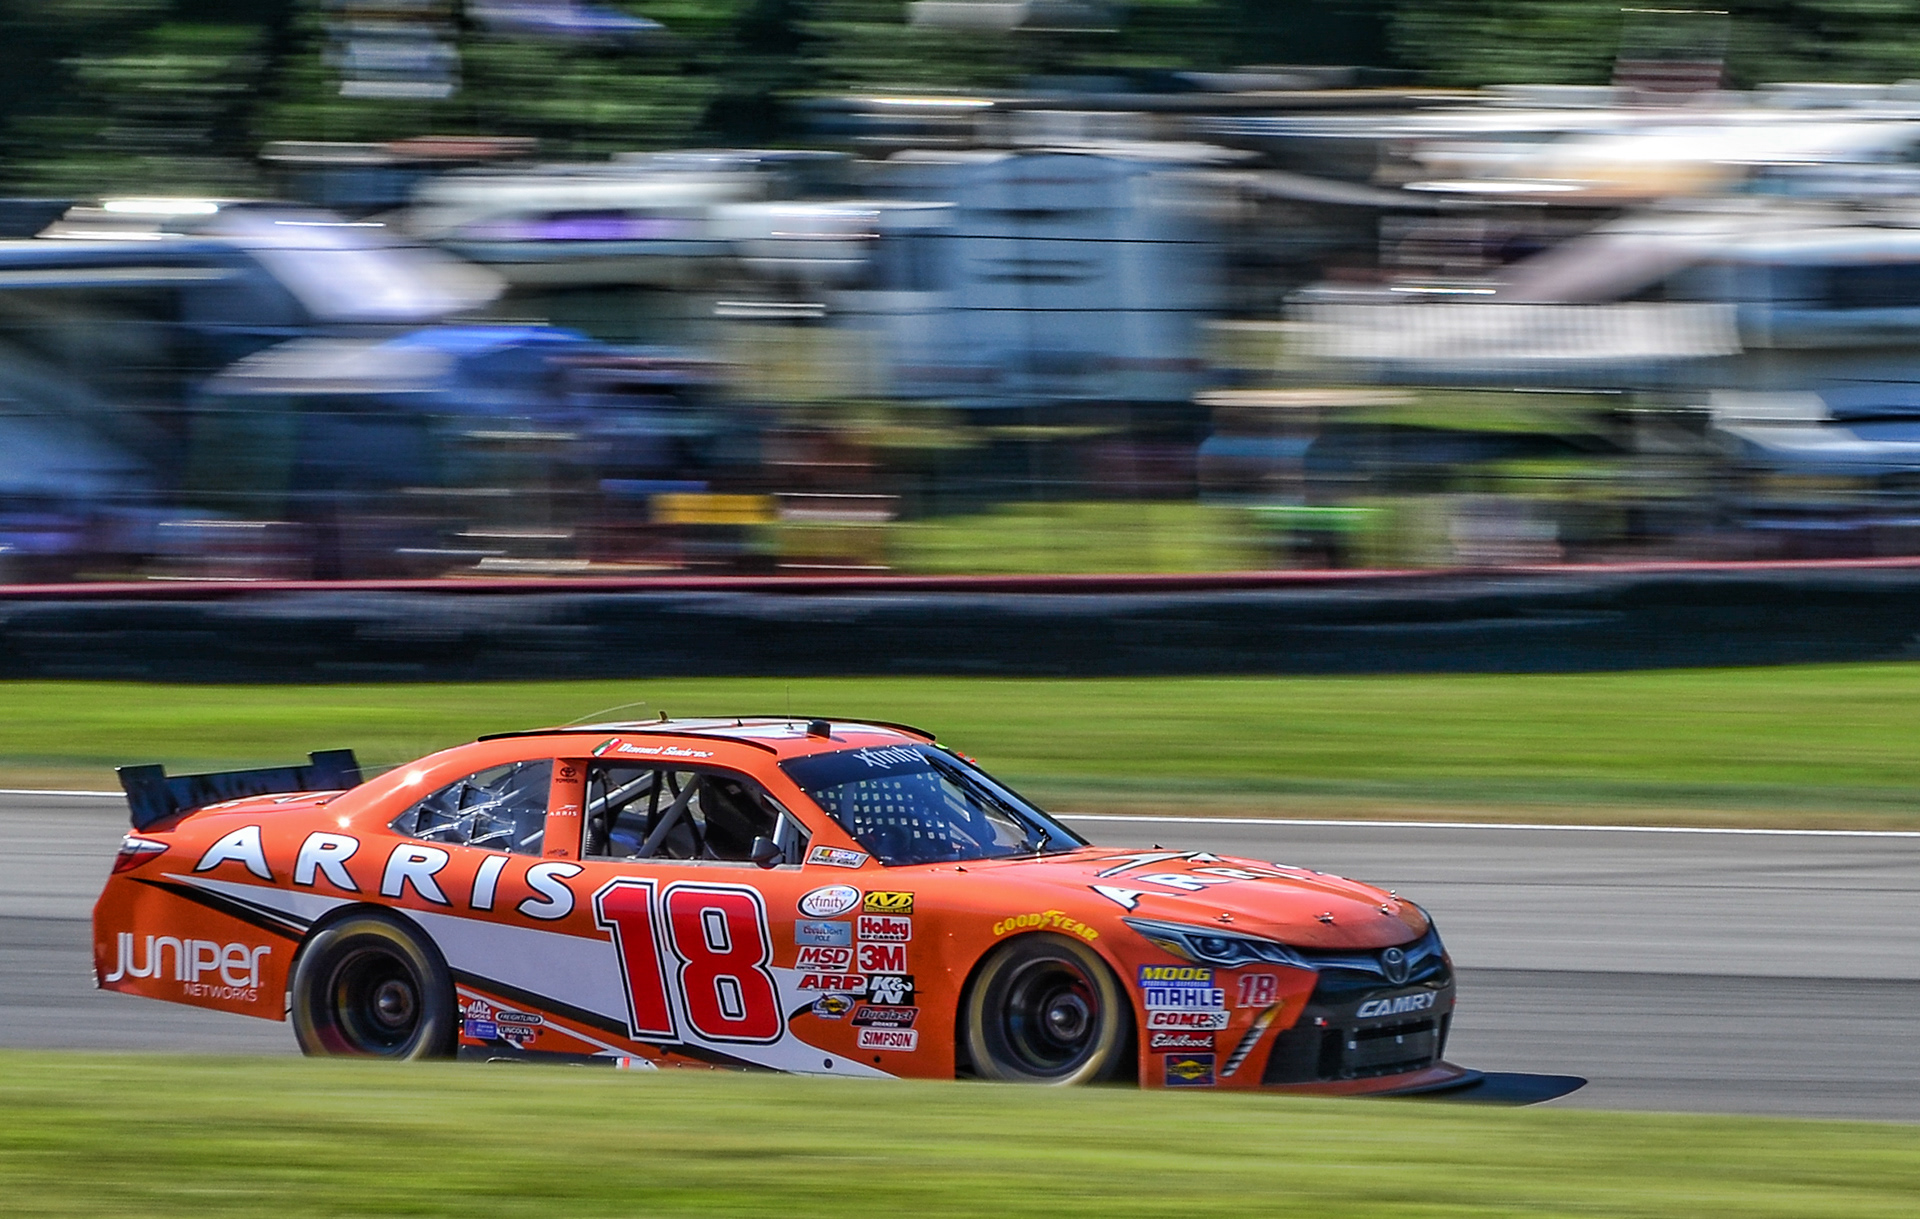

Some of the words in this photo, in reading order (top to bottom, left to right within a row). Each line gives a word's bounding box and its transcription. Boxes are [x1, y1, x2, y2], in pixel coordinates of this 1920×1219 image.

[853, 746, 930, 769] xfinity
[194, 824, 584, 920] ARRIS
[807, 895, 847, 909] xfinity
[861, 917, 908, 940] Holley
[993, 909, 1099, 941] GOODYEAR
[591, 876, 786, 1047] 18
[800, 947, 849, 964] MSD
[860, 944, 904, 971] 3M
[798, 974, 865, 990] ARP
[1142, 967, 1211, 981] MOOG
[183, 983, 258, 1002] NETWORKS
[1147, 988, 1223, 1006] MAHLE
[1235, 973, 1278, 1008] 18
[468, 1000, 491, 1014] MAC
[1356, 991, 1438, 1018] CAMRY
[859, 1007, 914, 1020] Duralast
[1154, 1012, 1209, 1025] COMP
[501, 1026, 529, 1035] LINCOLN
[862, 1030, 913, 1047] SIMPSON
[1151, 1032, 1214, 1048] Edelbrock
